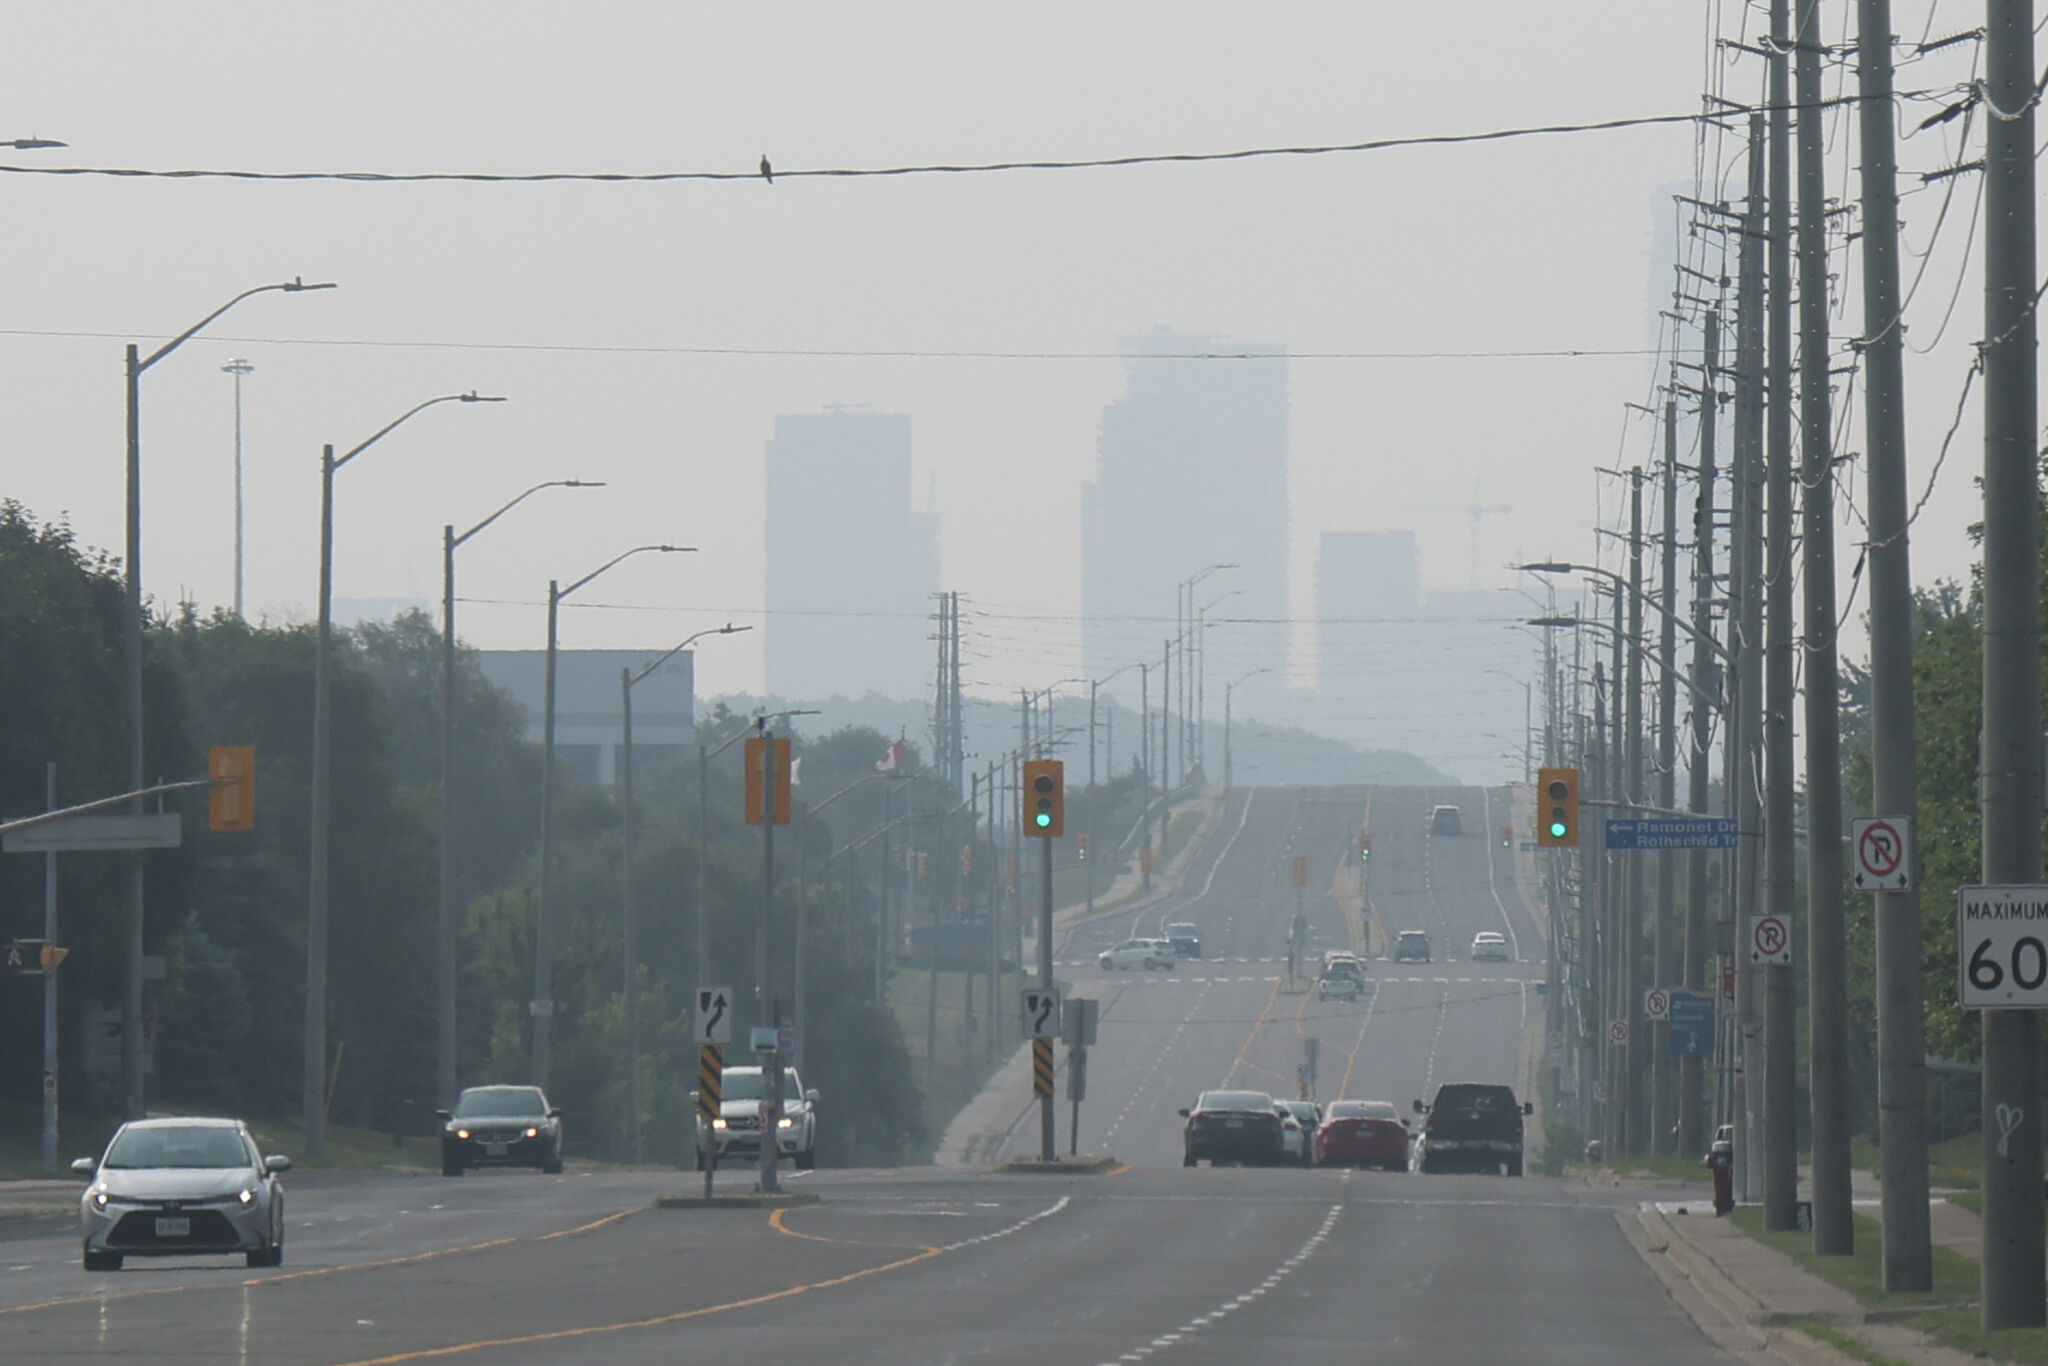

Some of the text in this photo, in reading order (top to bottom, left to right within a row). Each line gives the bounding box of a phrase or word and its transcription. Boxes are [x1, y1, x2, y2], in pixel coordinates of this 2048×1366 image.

[1637, 836, 1717, 847] Rothschild
[1966, 902, 2048, 920] MAXIMUM
[1969, 937, 2047, 991] 60
